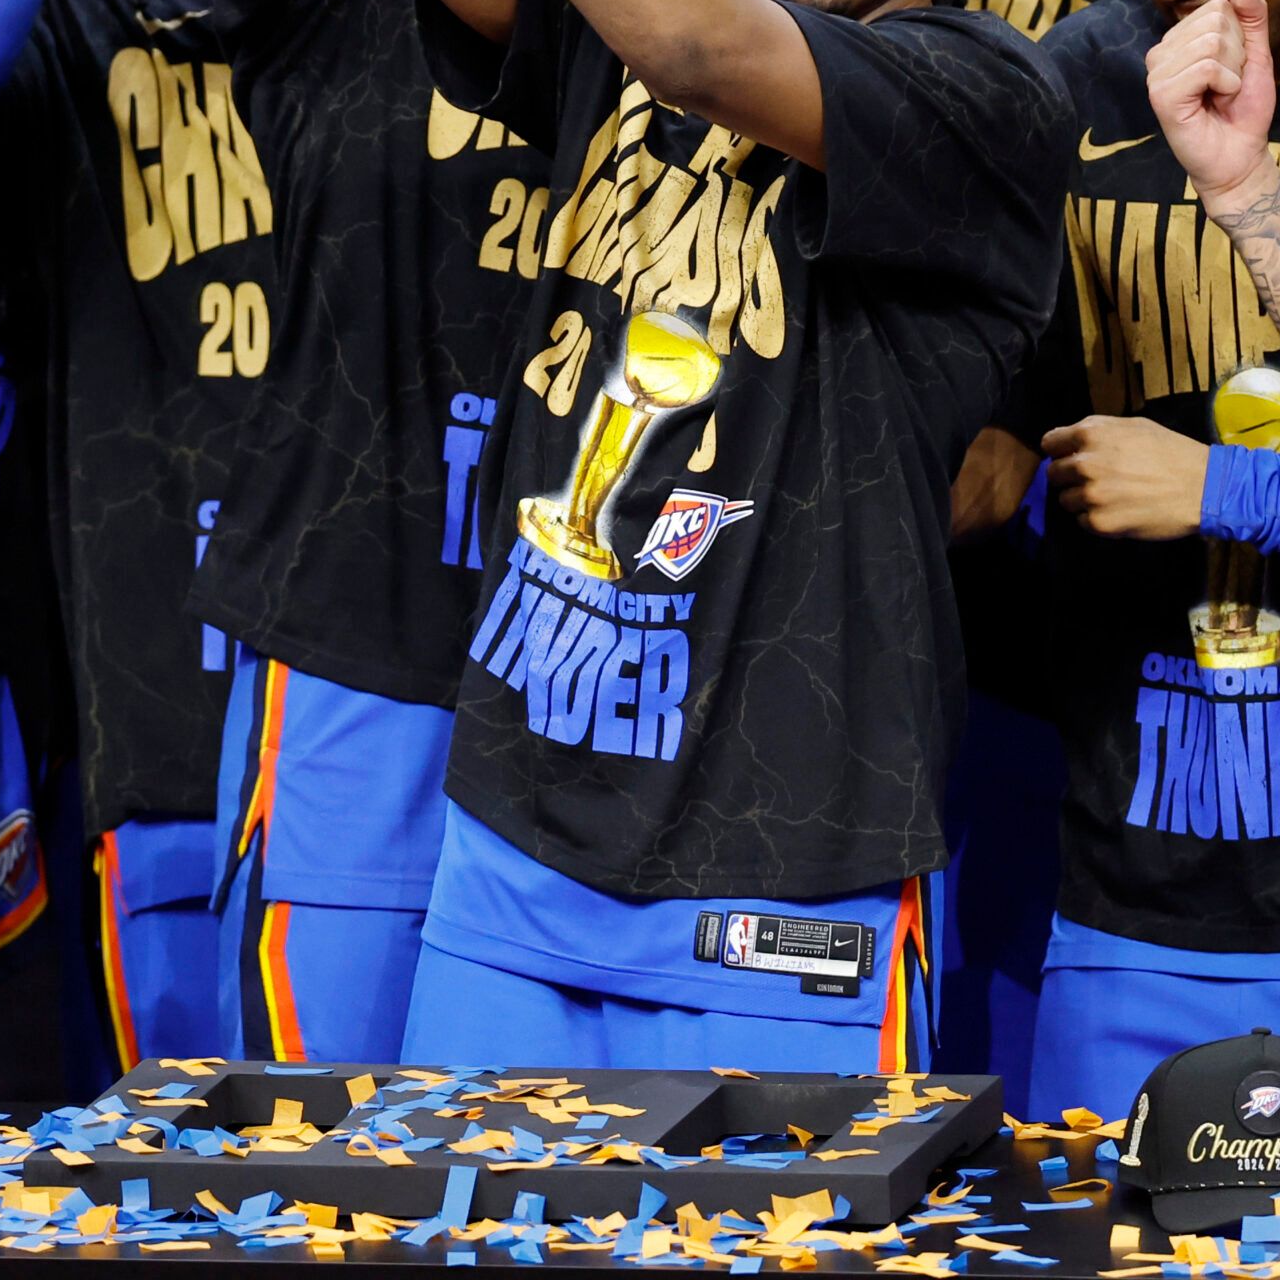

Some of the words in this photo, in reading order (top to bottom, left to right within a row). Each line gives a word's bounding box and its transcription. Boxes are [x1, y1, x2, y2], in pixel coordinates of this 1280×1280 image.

[198, 281, 271, 379] 20
[646, 505, 708, 548] OKC
[618, 591, 697, 623] CITY
[761, 930, 774, 942] 48
[782, 922, 829, 933] ENGINEERED
[1237, 1158, 1265, 1171] 2024
